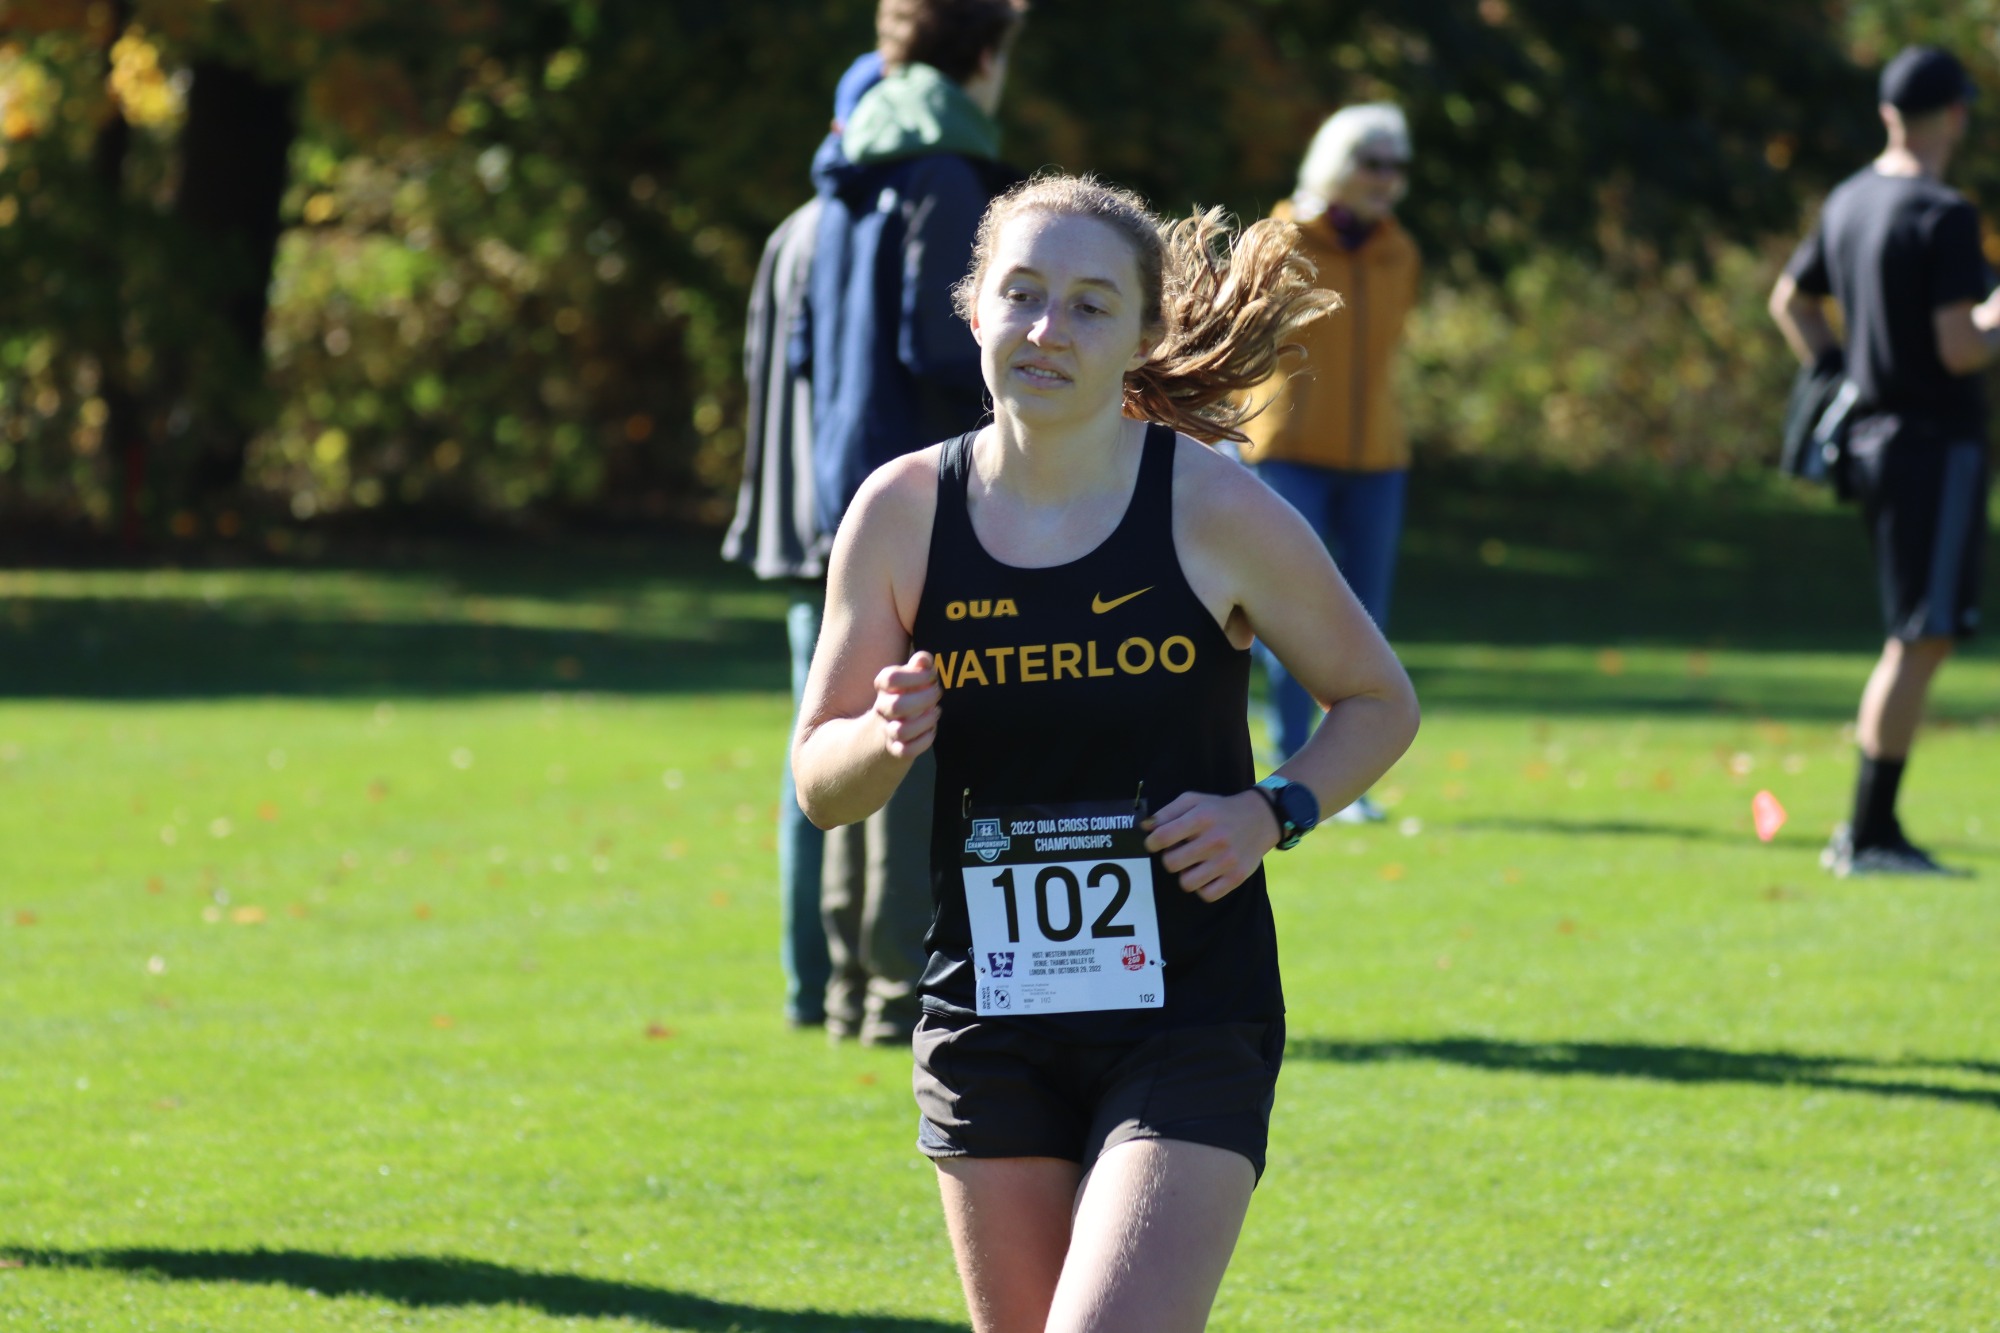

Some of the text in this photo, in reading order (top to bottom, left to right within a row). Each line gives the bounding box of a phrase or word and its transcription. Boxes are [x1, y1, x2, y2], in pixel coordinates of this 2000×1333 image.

[945, 598, 1019, 620] OUA
[934, 635, 1197, 690] WATERLOO
[1010, 815, 1135, 836] 2022 OUA CROSS COUNTRY
[967, 840, 1008, 849] CHAMPIONSHIPS
[1034, 834, 1113, 852] CHAMPIONSHIPS
[992, 862, 1136, 943] 102
[1139, 993, 1155, 1003] 102
